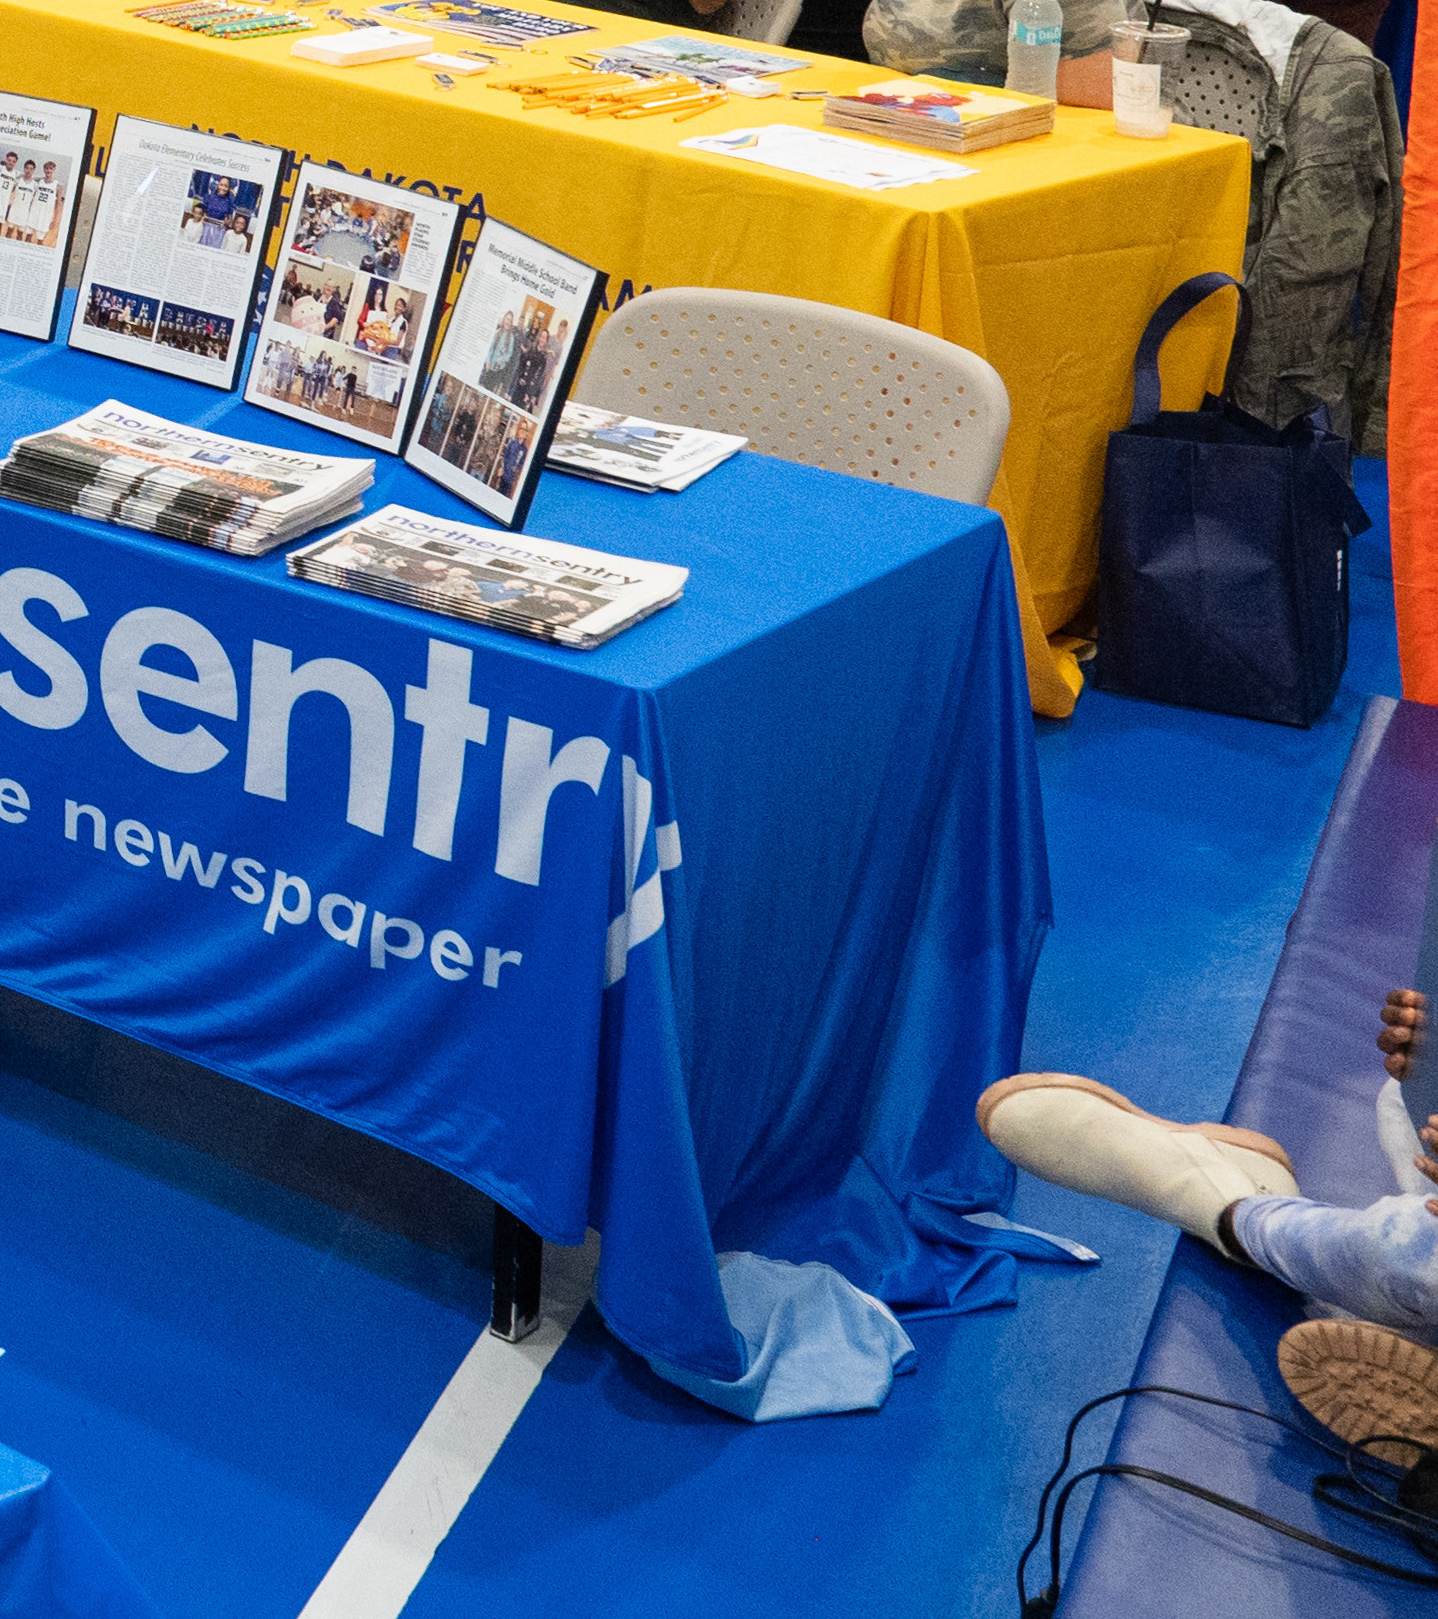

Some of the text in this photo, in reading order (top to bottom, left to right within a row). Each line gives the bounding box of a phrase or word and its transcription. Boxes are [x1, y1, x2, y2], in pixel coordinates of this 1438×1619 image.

[9, 113, 25, 127] High
[26, 117, 46, 129] Hosts
[29, 129, 52, 142] Game!
[161, 143, 195, 161] Elementary
[488, 242, 578, 295] Memorial Middle School Band
[500, 264, 556, 299] Brings Home Gold
[387, 514, 644, 587] northernsentry
[64, 796, 522, 990] newspaper
